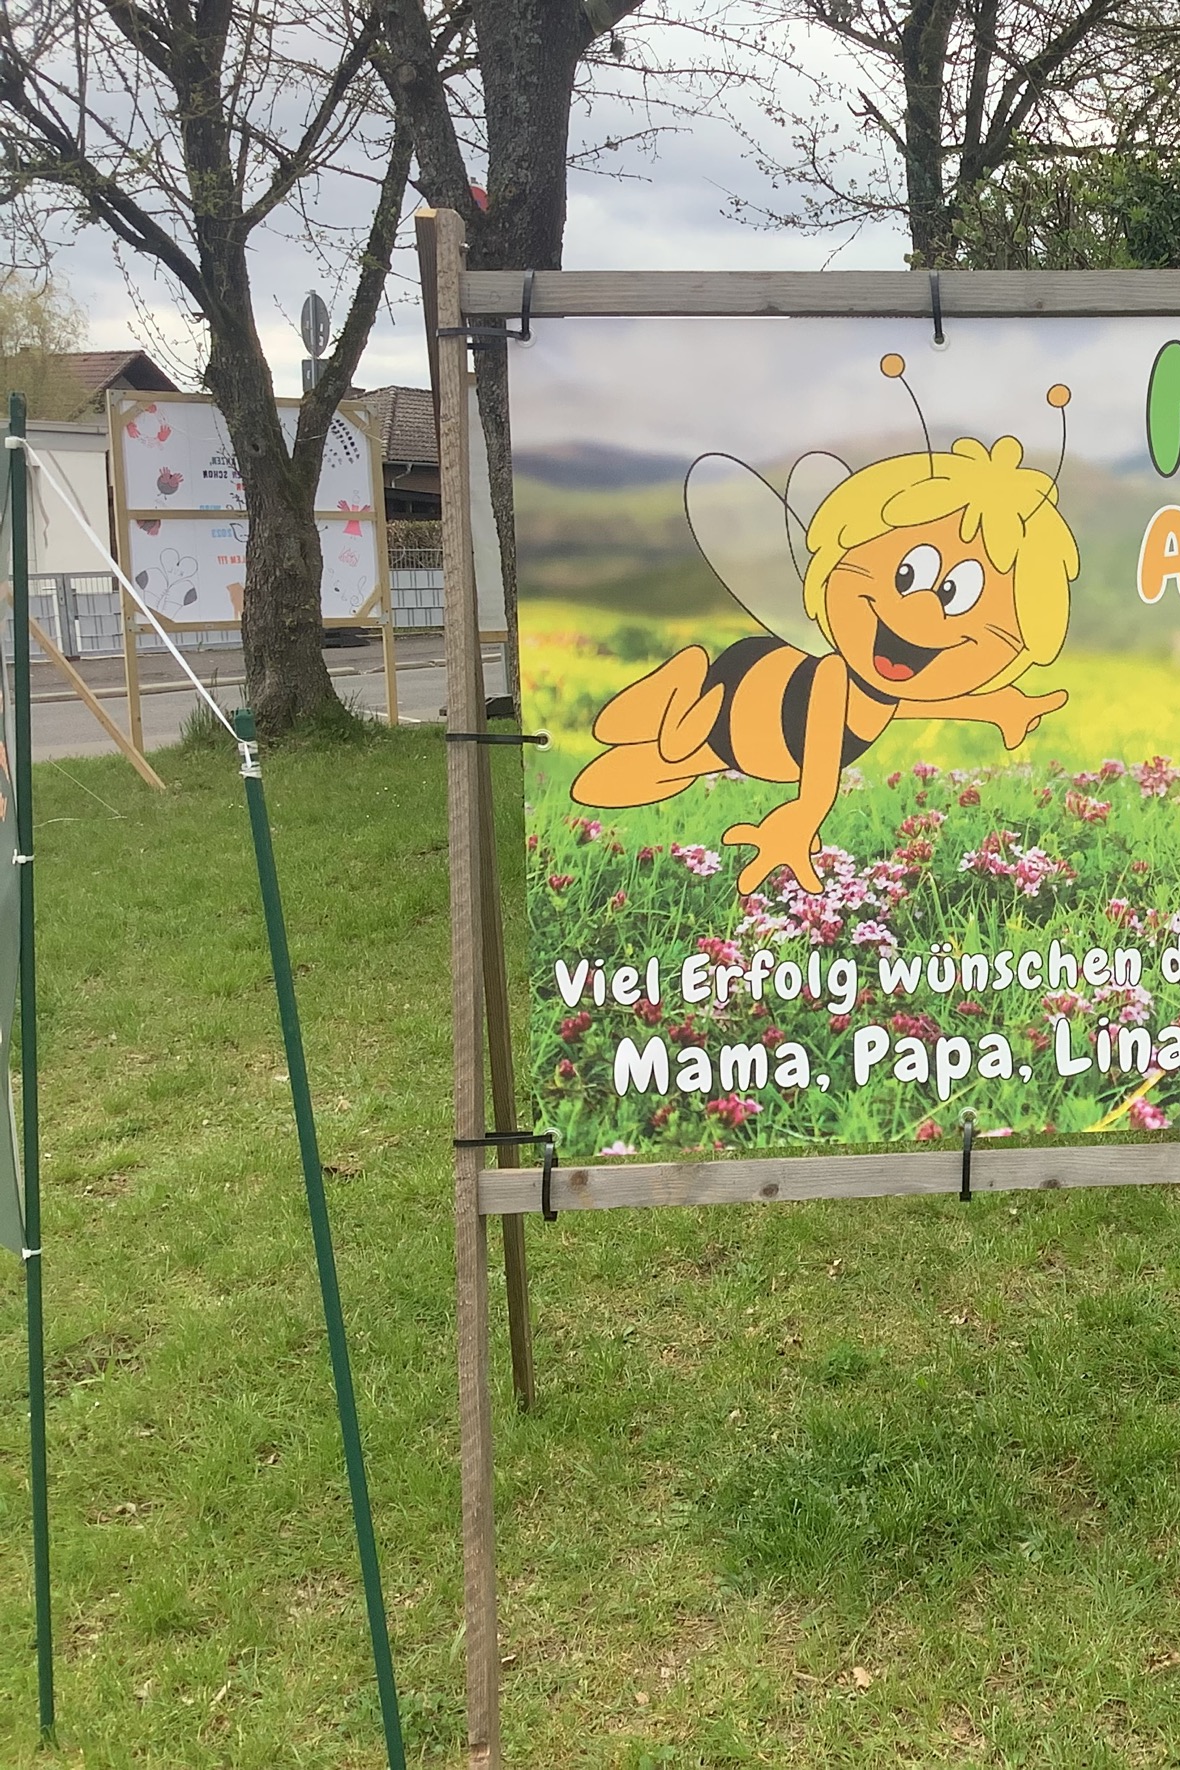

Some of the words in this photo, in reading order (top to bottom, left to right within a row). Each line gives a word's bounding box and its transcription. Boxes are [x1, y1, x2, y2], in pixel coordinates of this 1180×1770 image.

[554, 956, 661, 1009] Viel
[680, 948, 858, 1015] Erfolg
[880, 940, 1144, 995] wünschen
[613, 1036, 832, 1097] Mama,
[851, 1024, 1033, 1101] Papa,
